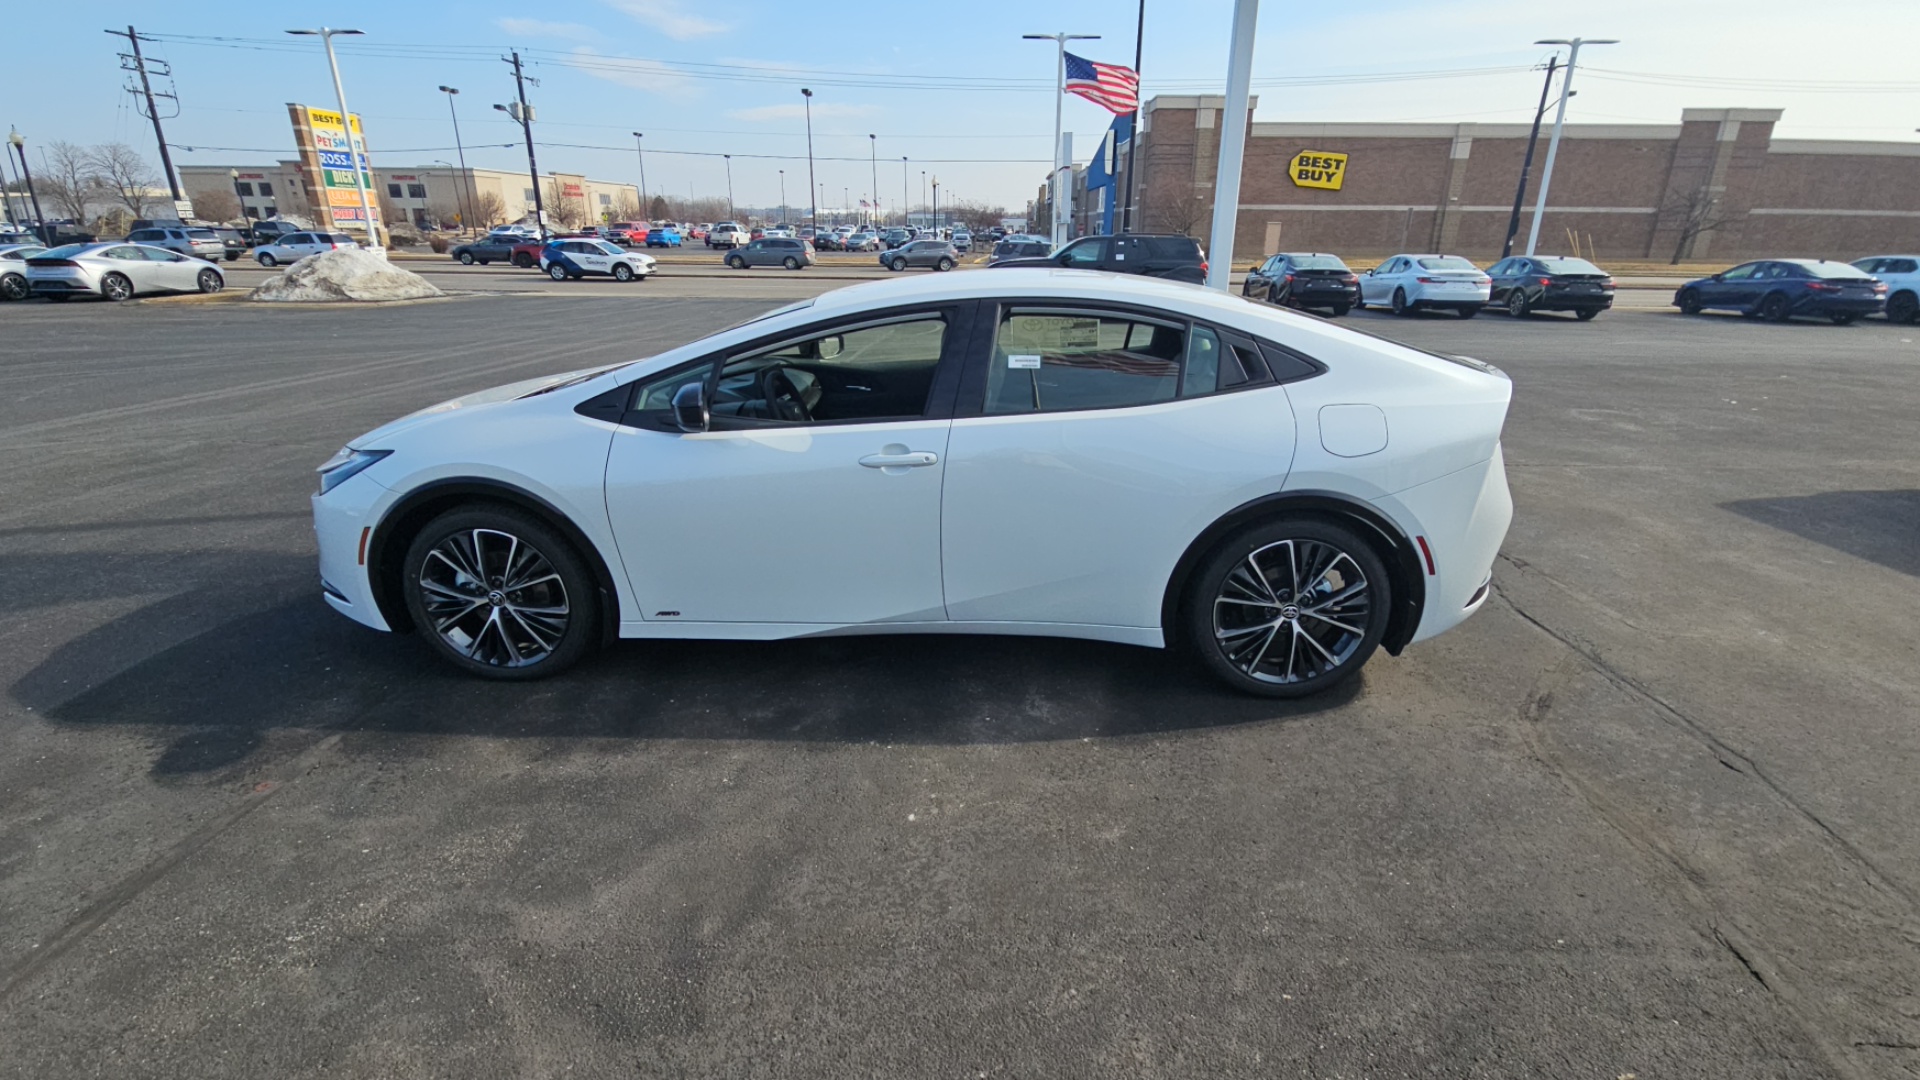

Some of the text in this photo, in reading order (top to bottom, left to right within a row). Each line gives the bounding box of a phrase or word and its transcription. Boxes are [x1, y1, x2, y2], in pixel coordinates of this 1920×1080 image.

[312, 113, 353, 127] BEST BY
[1298, 155, 1345, 171] BEST
[1297, 168, 1338, 183] BUY
